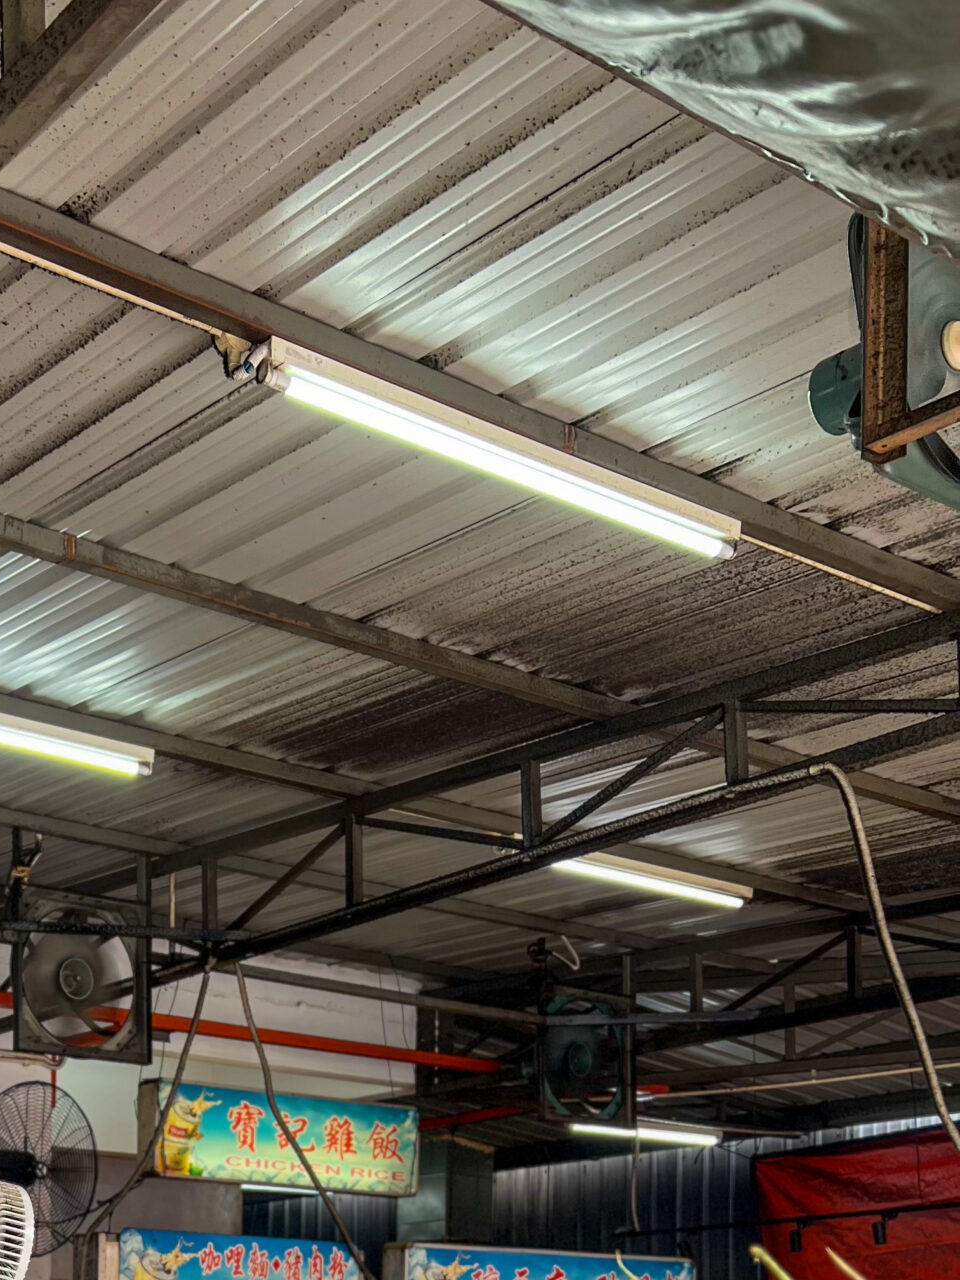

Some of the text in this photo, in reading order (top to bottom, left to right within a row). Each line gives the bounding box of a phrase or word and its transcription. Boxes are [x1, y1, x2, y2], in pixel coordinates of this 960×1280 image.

[228, 1101, 404, 1163] 寶記雞飯
[350, 1168, 406, 1182] RICE
